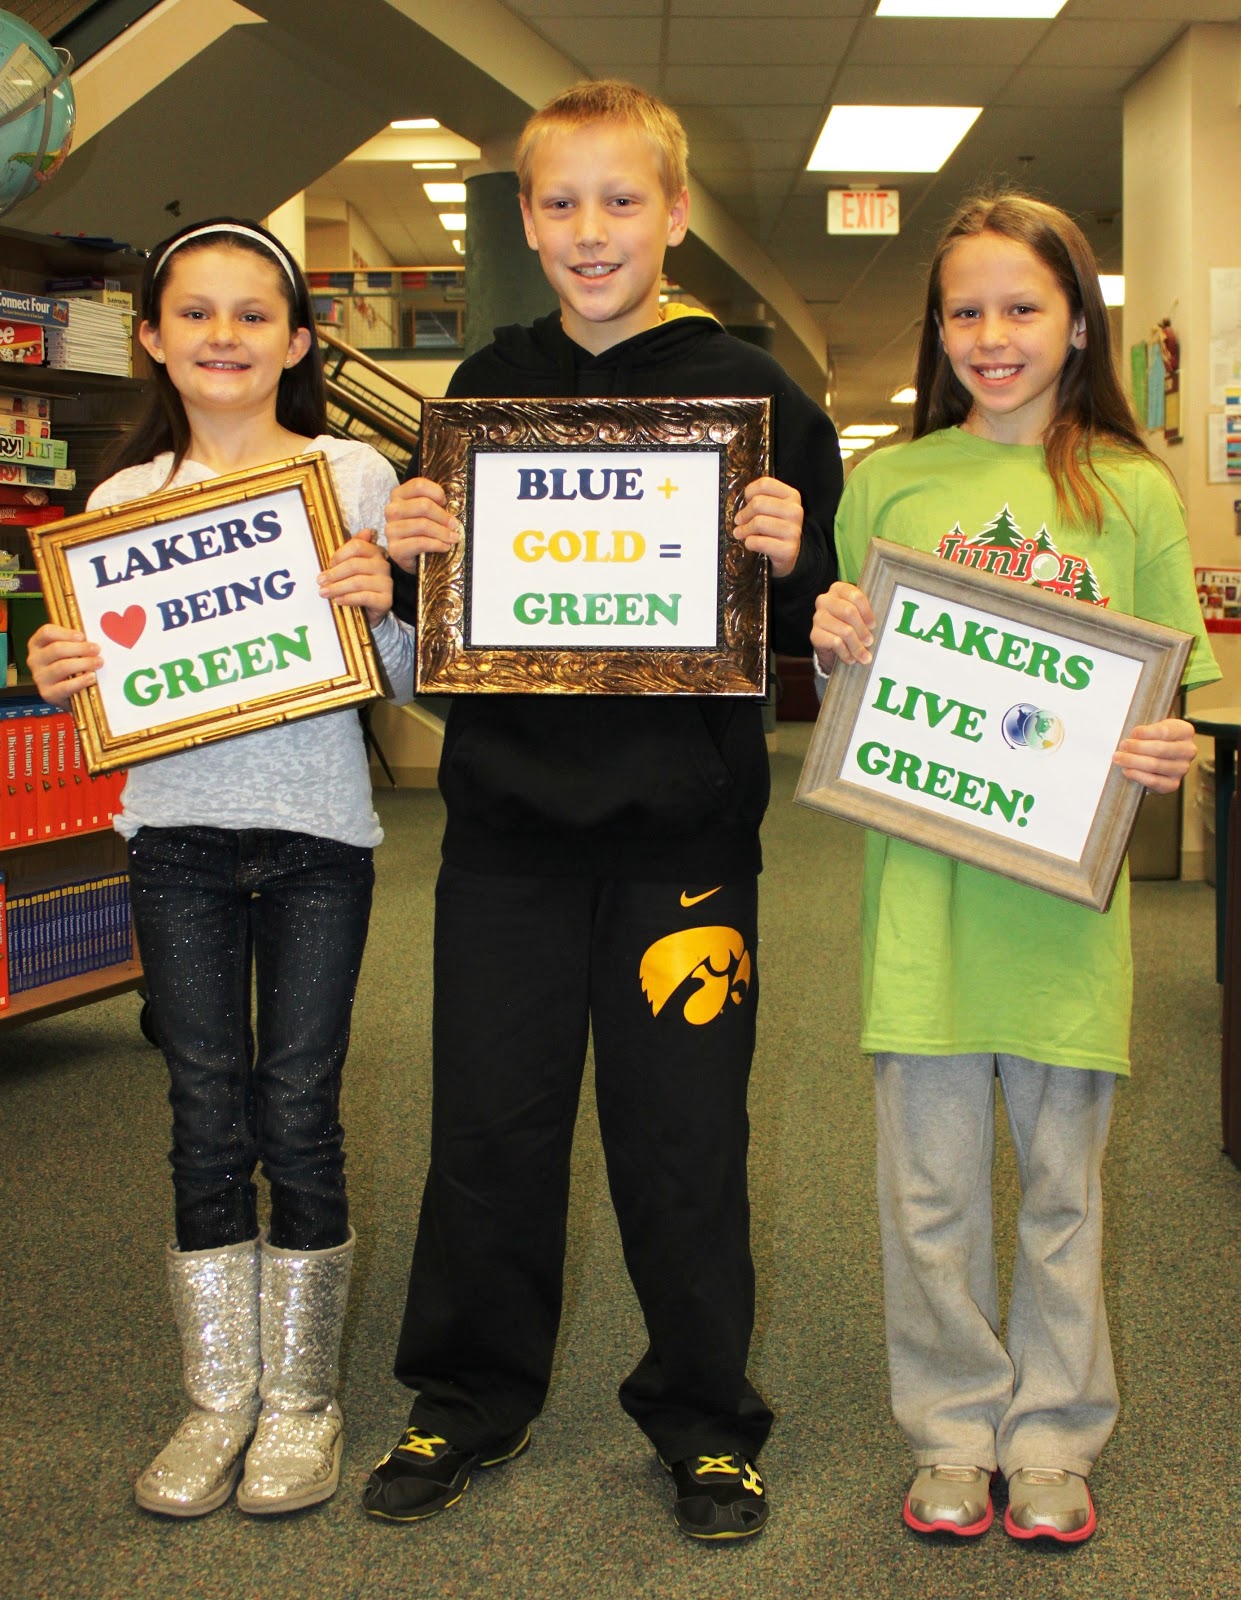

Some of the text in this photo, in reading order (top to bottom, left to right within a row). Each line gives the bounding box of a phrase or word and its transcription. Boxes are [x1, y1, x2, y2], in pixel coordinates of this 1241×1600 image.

[842, 192, 888, 229] EXIT
[31, 297, 51, 314] Four
[516, 468, 679, 500] BLUE +
[89, 510, 282, 588] LAKERS
[512, 530, 682, 563] GOLD =
[156, 569, 296, 631] BEING
[513, 592, 682, 626] GREEN
[123, 625, 312, 707] GREEN
[894, 600, 1094, 690] LAKERS
[871, 677, 987, 743] LIVE
[7, 736, 16, 779] Dictionary
[24, 734, 33, 777] Dictionary
[41, 732, 50, 775] Dictionary
[57, 730, 66, 772] Dictionary
[856, 741, 1036, 828] GREEN!
